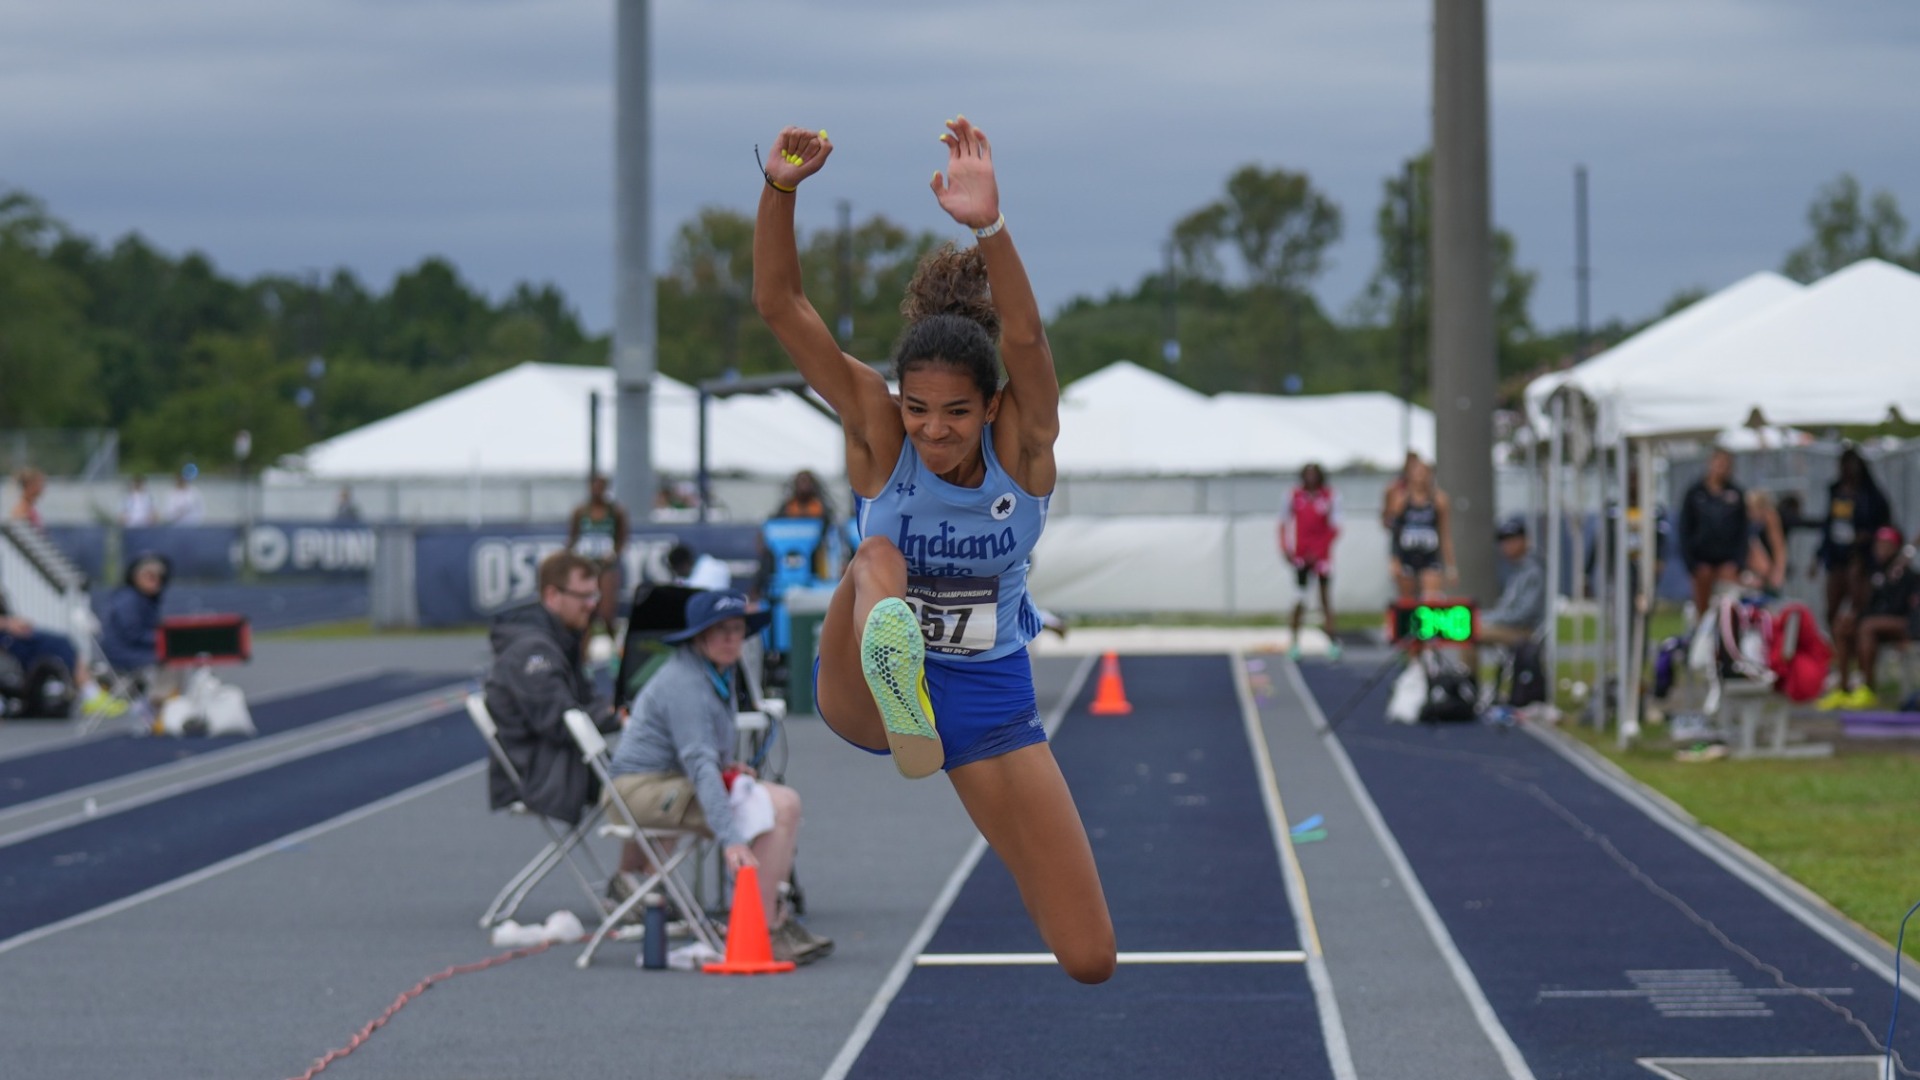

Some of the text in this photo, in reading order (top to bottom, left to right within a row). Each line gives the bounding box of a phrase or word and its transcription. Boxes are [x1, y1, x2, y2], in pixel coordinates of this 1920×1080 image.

[900, 514, 1017, 561] Indiana
[919, 588, 937, 598] FIELD
[937, 589, 993, 598] CHAMPIONSHIPS
[906, 602, 973, 644] 57
